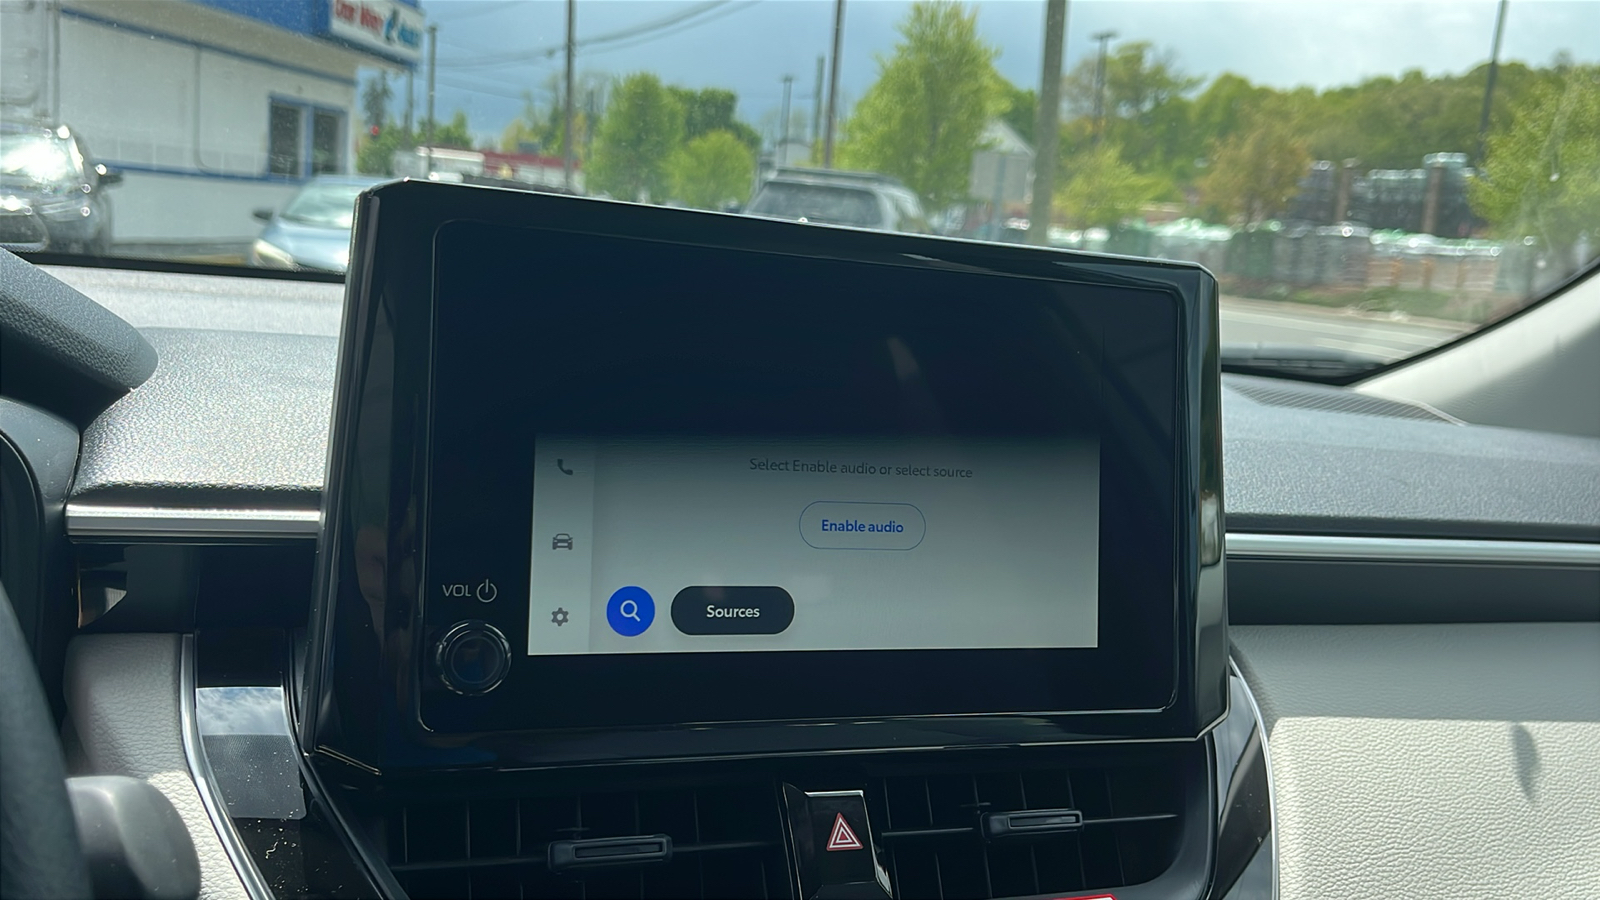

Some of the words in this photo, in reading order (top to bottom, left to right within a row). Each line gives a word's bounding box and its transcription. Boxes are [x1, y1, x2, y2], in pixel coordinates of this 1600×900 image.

[749, 458, 790, 472] Select
[792, 459, 838, 473] Enable
[840, 462, 877, 475] audio
[879, 465, 893, 476] or
[895, 465, 932, 477] select
[933, 468, 973, 478] source
[821, 519, 866, 533] Enable
[868, 521, 904, 533] audio
[442, 584, 472, 598] VOL
[706, 604, 760, 619] Sources
